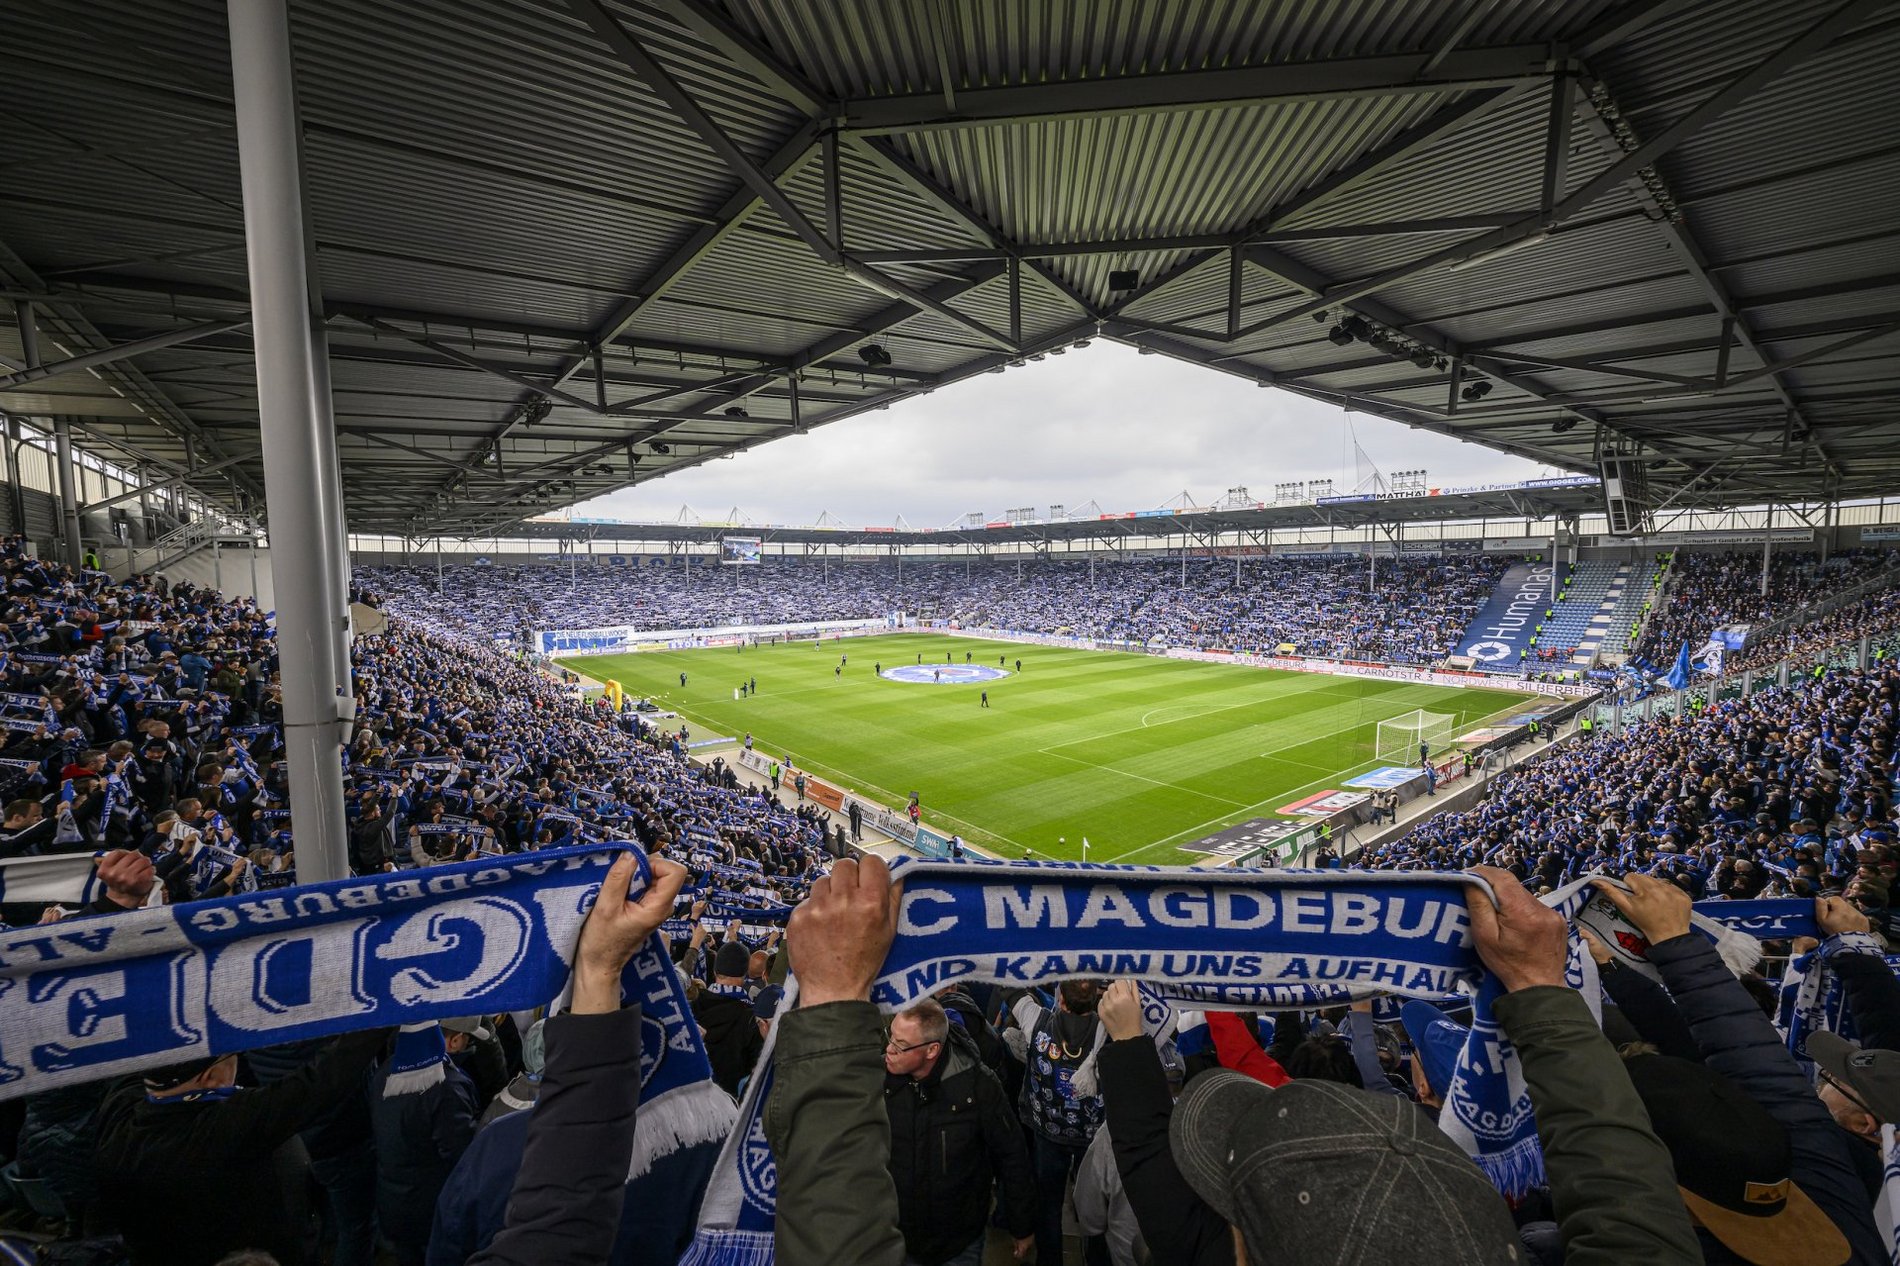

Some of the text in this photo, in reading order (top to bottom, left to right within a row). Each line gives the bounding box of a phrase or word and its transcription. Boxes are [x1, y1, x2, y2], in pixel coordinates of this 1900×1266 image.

[1489, 482, 1517, 491] Partner
[1481, 567, 1554, 640] Humanas
[1253, 658, 1307, 669] MAGDEBURG
[982, 883, 1476, 949] MAGDEBUR
[994, 953, 1150, 981] KANN
[1160, 953, 1263, 978] UNS
[1277, 957, 1456, 993] AUFHAL
[749, 1116, 777, 1191] MAG
